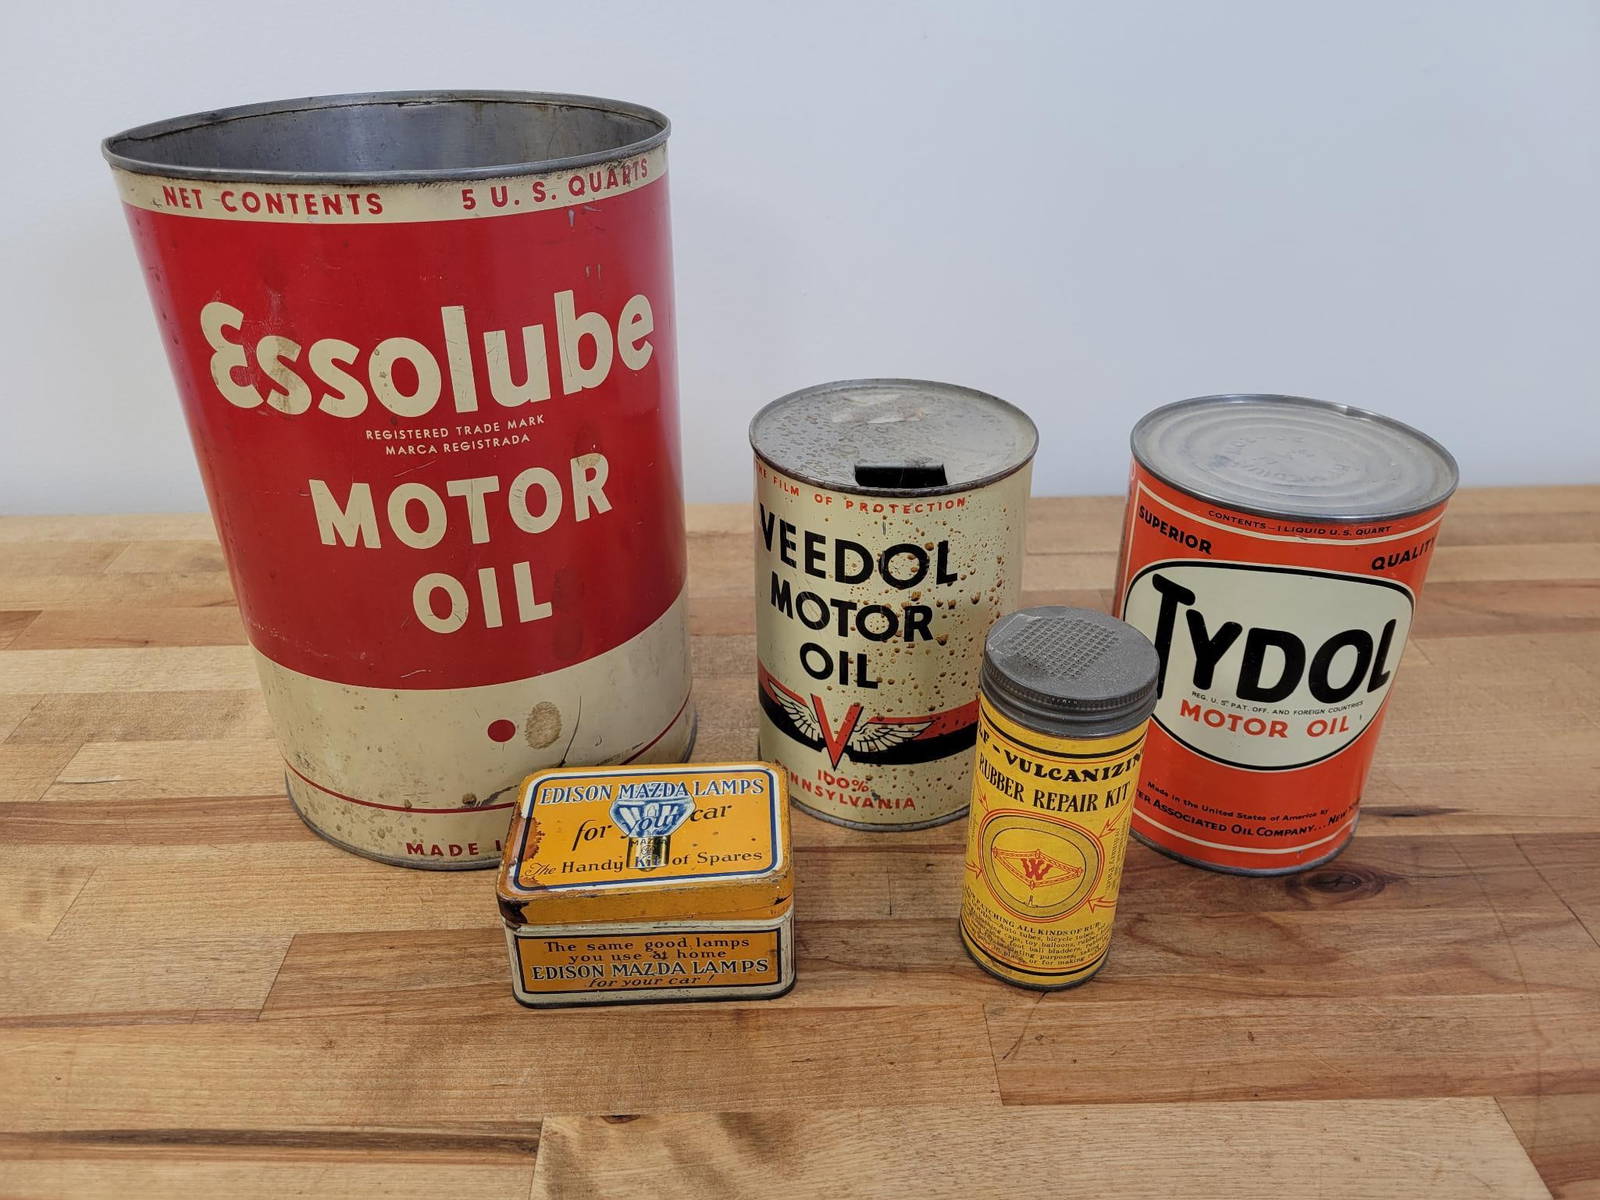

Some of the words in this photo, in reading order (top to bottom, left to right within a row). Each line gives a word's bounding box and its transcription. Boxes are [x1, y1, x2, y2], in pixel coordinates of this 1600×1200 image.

[162, 185, 204, 211] NET
[221, 189, 384, 216] CONTENTS
[460, 188, 477, 211] 5
[568, 157, 649, 198] QUARTS
[199, 289, 656, 419] Essolube
[365, 425, 450, 442] REGISTERED
[456, 420, 502, 437] TRADE
[507, 413, 545, 431] MARK
[385, 440, 438, 457] MARCA
[443, 433, 532, 454] REGISTRADA
[308, 452, 613, 550] MOTOR
[773, 475, 800, 497] FILM
[814, 493, 833, 506] OF
[845, 496, 967, 515] PROTECTION
[1138, 504, 1213, 556] SUPERIOR
[1208, 510, 1266, 530] CONTENTS
[1284, 525, 1327, 535] LIQUID
[1355, 525, 1393, 536] QUART
[759, 502, 959, 591] VEEDOL
[412, 561, 553, 634] OIL
[771, 571, 935, 643] MOTOR
[1152, 573, 1397, 704] TYDOL
[799, 642, 880, 690] OIL
[1179, 699, 1289, 739] MOTOR
[1306, 714, 1350, 738] OIL
[1293, 708, 1326, 716] FOREIGN
[1328, 700, 1364, 714] COUNTRIES
[817, 768, 870, 793] 100%
[979, 751, 1025, 804] RUBBER
[1032, 788, 1098, 813] REPAIR
[1104, 780, 1130, 809] KIT
[1004, 748, 1143, 783] VULCANIZIN
[541, 784, 612, 805] EDISON
[618, 781, 690, 801] MAZDA
[695, 778, 765, 798] LAMPS
[784, 766, 916, 811] NNSYLVANIA
[1147, 781, 1169, 797] Made
[1184, 799, 1199, 809] the
[1201, 804, 1234, 817] United
[1236, 811, 1267, 821] States
[1282, 811, 1317, 822] America
[572, 819, 613, 852] for
[620, 810, 683, 840] your
[690, 804, 733, 823] car
[1153, 799, 1228, 832] ASSOCIATED
[1231, 823, 1255, 836] OIL
[405, 842, 479, 857] MADE
[525, 862, 557, 877] The
[561, 859, 624, 874] Handy
[671, 853, 690, 866] of
[697, 850, 763, 864] Spares
[544, 940, 577, 954] The
[586, 940, 634, 951] same
[644, 936, 688, 952] good
[695, 937, 750, 951] lamps
[1017, 924, 1036, 934] ALL
[531, 965, 605, 981] EDISON
[612, 962, 687, 978] MAZDA
[693, 958, 769, 974] LAMPS
[568, 953, 602, 965] you
[610, 951, 643, 962] use
[676, 948, 727, 960] home
[588, 977, 617, 990] for
[620, 976, 665, 989] your
[669, 975, 701, 986] car
